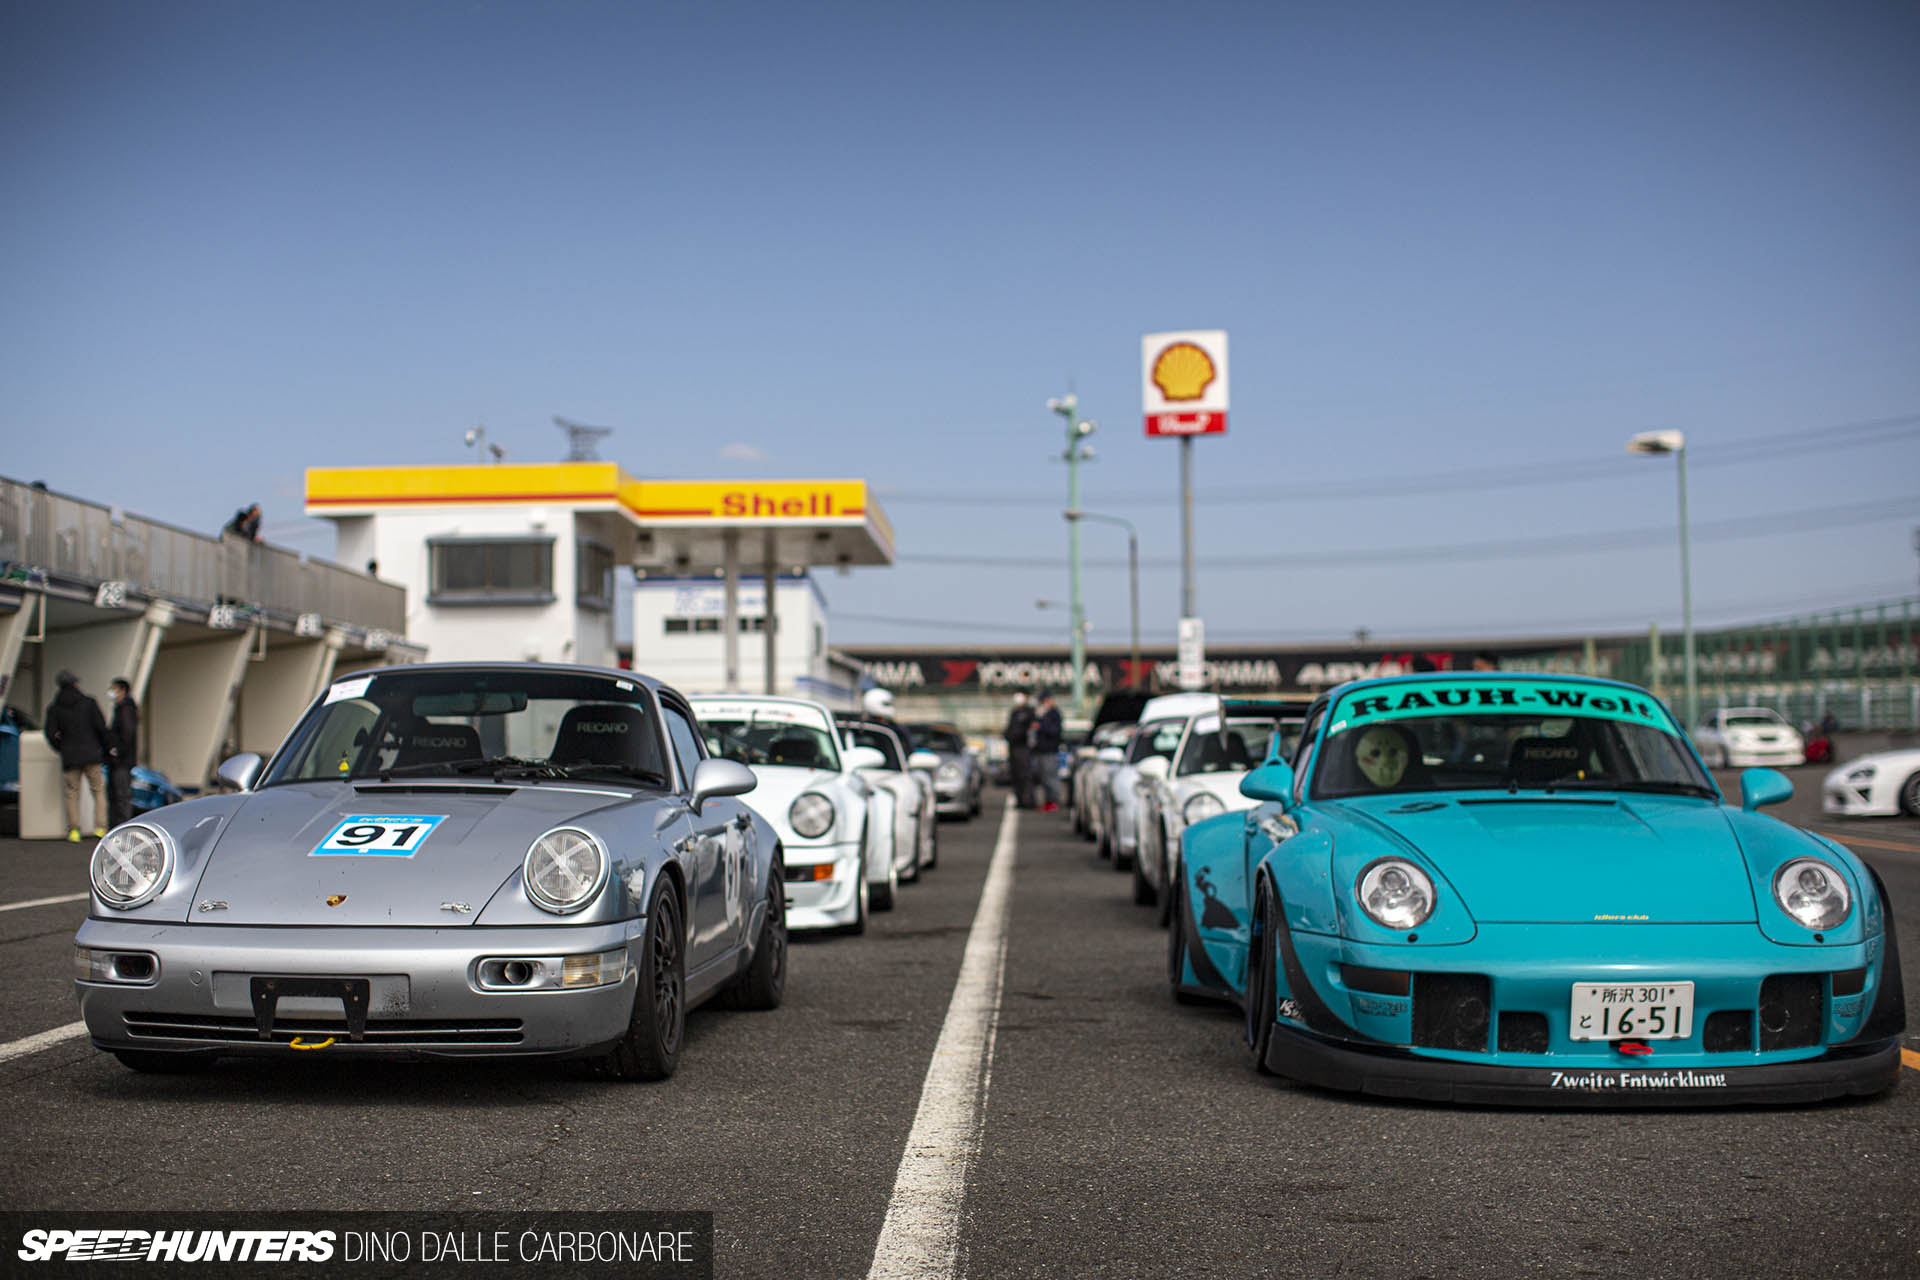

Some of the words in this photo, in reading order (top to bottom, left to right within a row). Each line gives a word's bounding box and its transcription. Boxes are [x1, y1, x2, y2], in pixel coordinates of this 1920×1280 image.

[722, 492, 834, 517] Shell
[1351, 688, 1655, 720] RAUH-Welt
[576, 721, 629, 734] RECARO
[336, 825, 419, 846] 91
[1602, 988, 1634, 1003] 所沢
[1639, 987, 1665, 1003] 301
[1579, 1015, 1592, 1028] と
[1603, 1006, 1681, 1035] 16-51
[1551, 1072, 1616, 1089] Zweite
